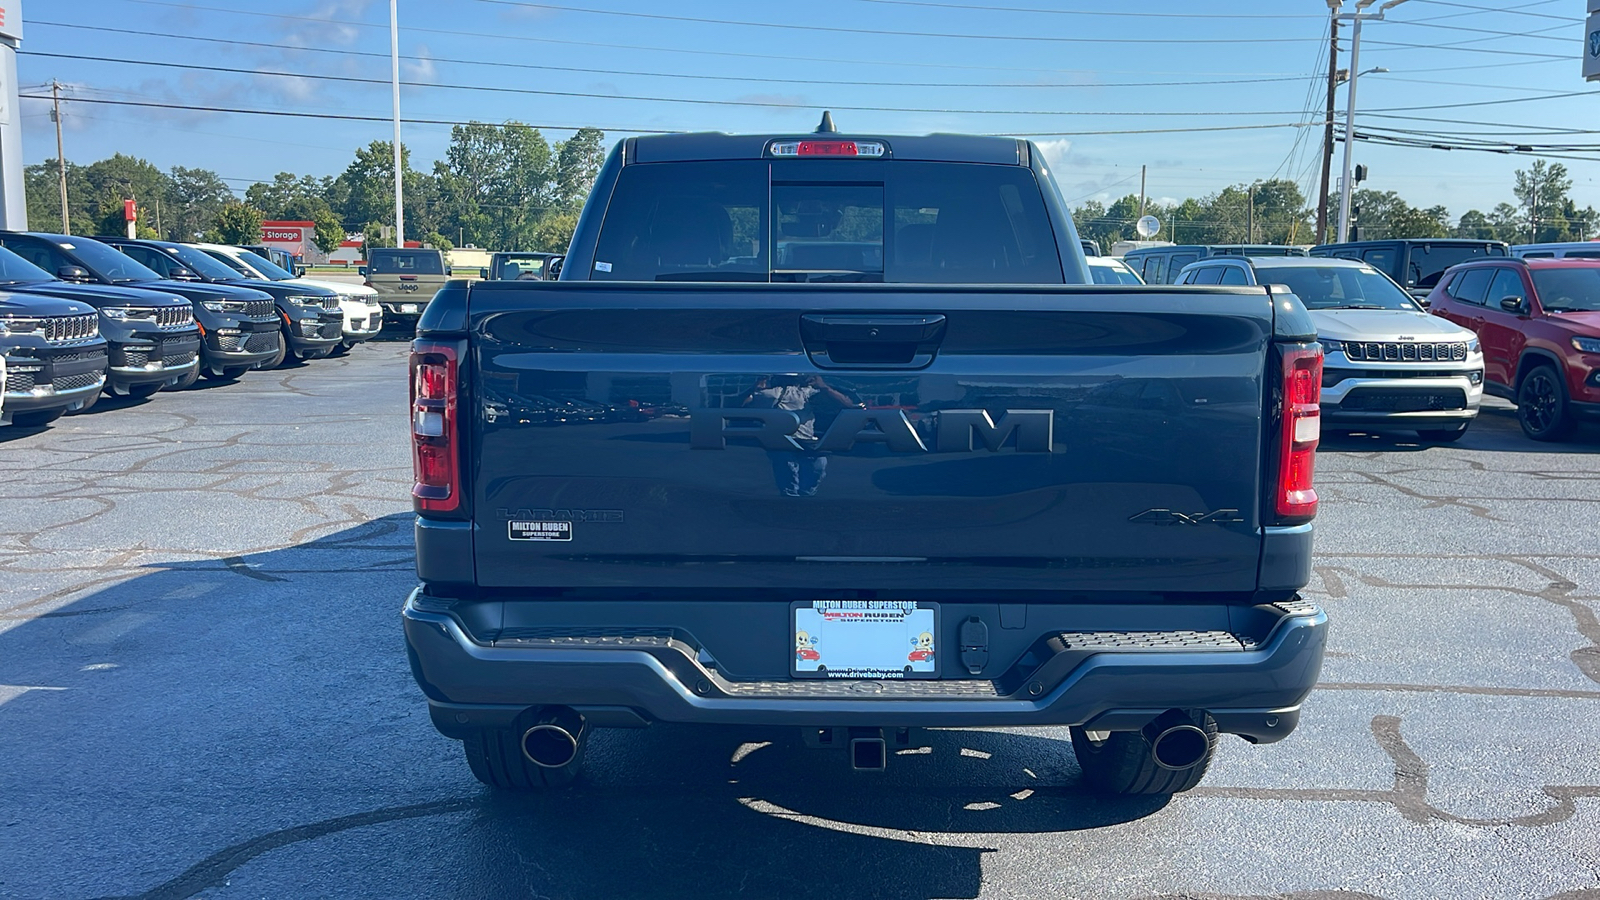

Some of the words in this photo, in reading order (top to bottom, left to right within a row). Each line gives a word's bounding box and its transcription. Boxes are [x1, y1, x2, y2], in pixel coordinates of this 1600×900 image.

[267, 231, 298, 241] Storage
[398, 283, 418, 291] Jeep
[690, 408, 1054, 452] RAM
[496, 508, 624, 522] LARAMIE
[512, 522, 541, 531] MILTON
[542, 522, 568, 531] RUBEN
[812, 600, 840, 609] MILTON
[842, 600, 868, 609] RUBEN
[868, 600, 918, 610] SUPERSTORE
[828, 671, 904, 679] www.drivebaby.com
